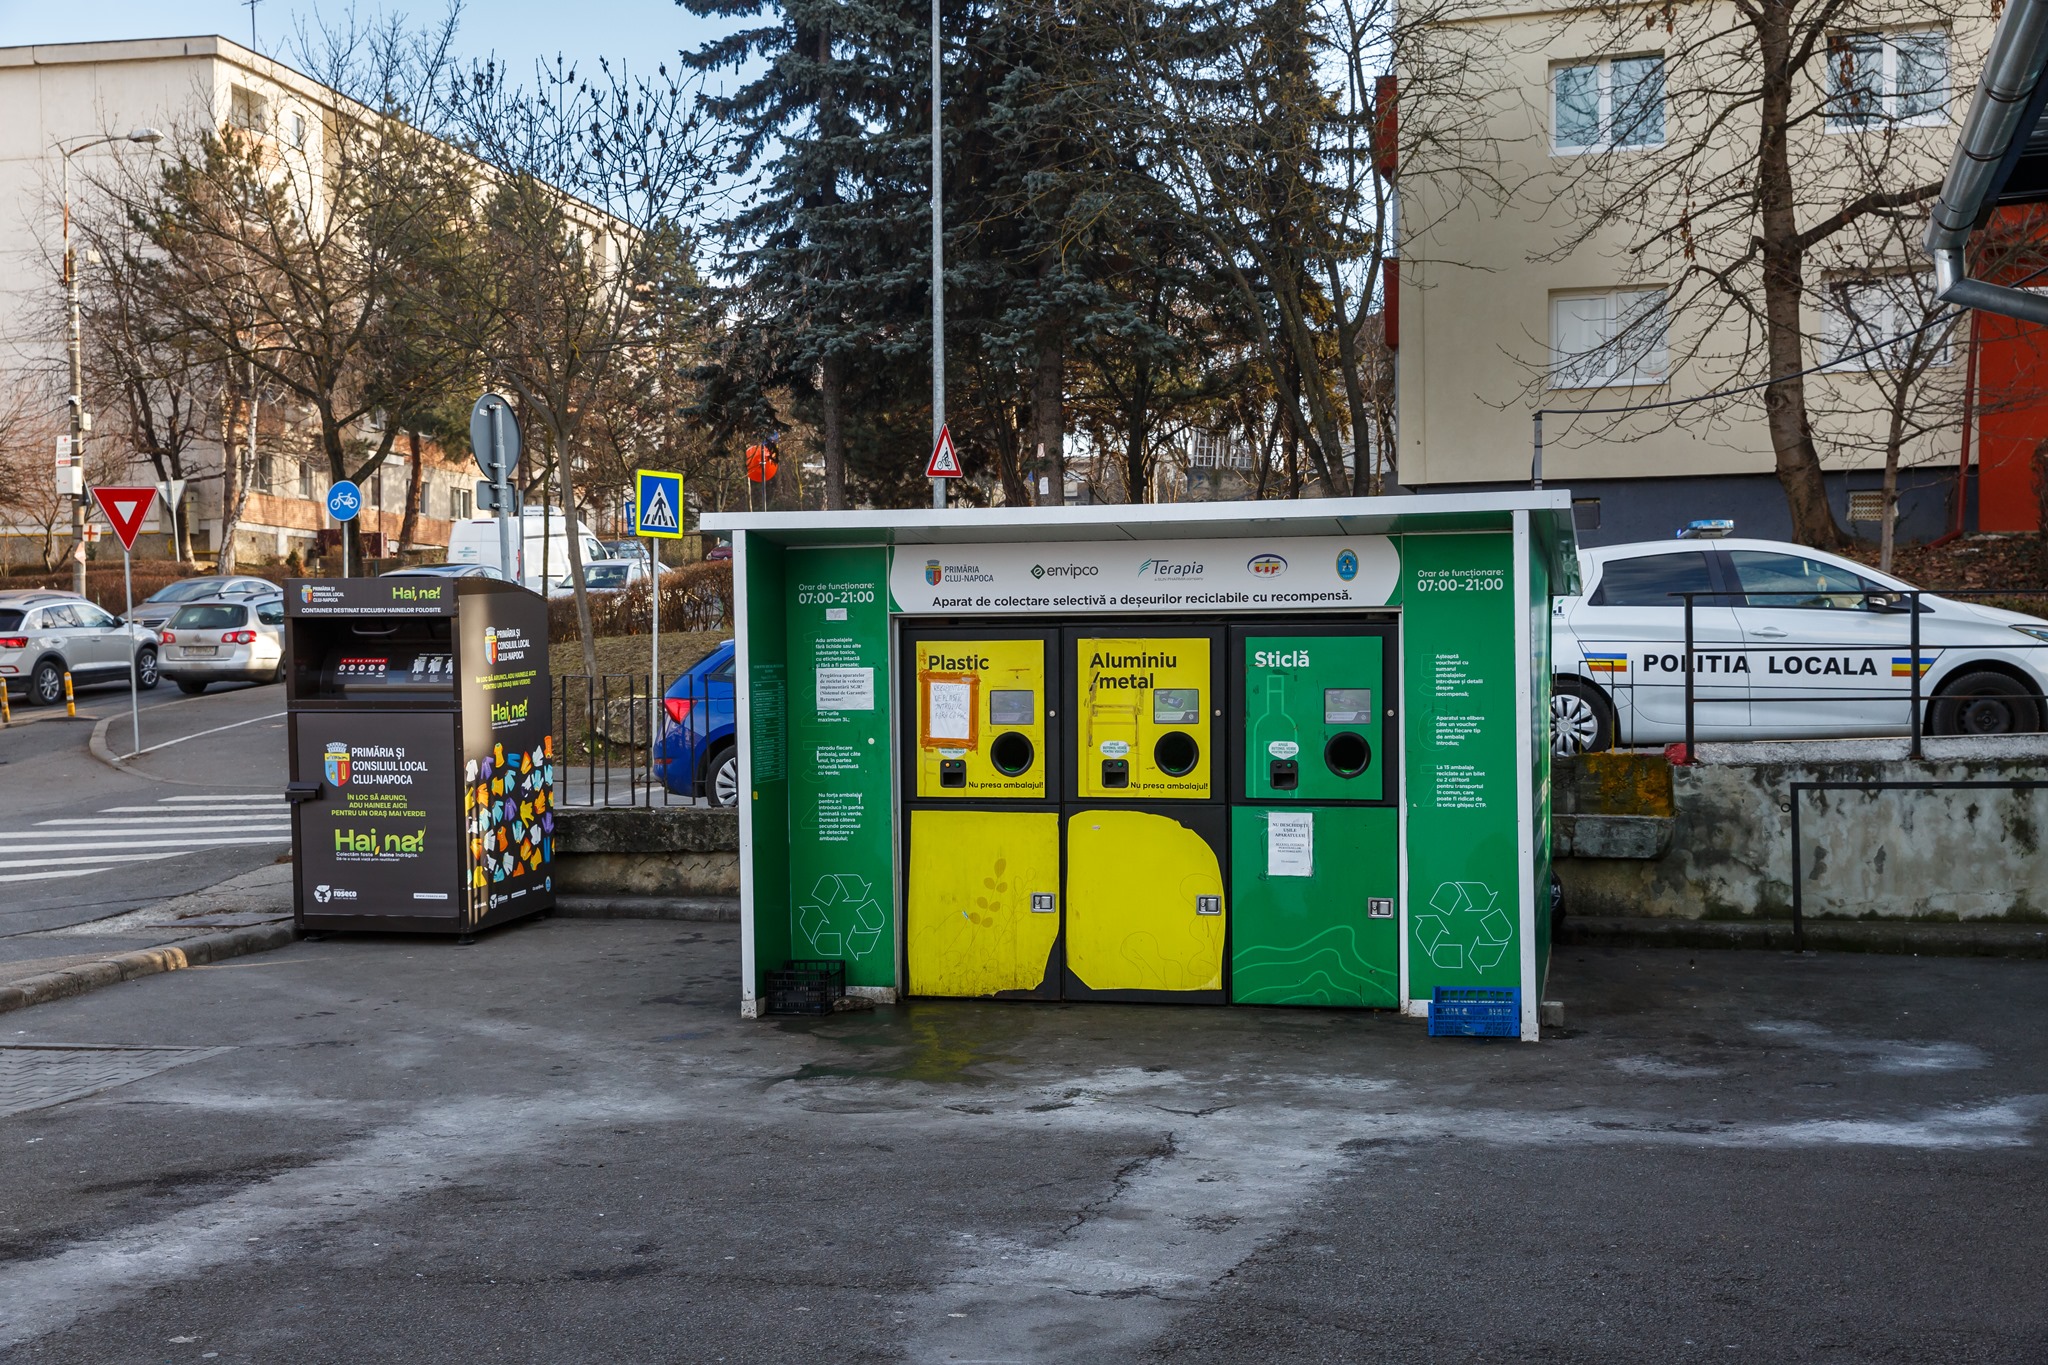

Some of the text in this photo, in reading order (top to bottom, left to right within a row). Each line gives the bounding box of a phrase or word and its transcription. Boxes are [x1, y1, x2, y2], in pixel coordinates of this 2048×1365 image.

[944, 564, 980, 574] PRIMĂRIA
[1047, 563, 1098, 579] envipco
[1151, 560, 1204, 576] Terapia
[1452, 568, 1504, 578] funcționare:
[944, 574, 994, 583] CLUJ-NAPOCA
[817, 582, 826, 590] de
[828, 582, 874, 592] funcționare:
[932, 596, 972, 608] Aparat
[976, 596, 990, 606] de
[994, 596, 1050, 606] colectare
[1053, 594, 1106, 606] selectivă
[1120, 594, 1182, 608] deșeurilor
[1186, 592, 1249, 604] reciclabile
[1253, 594, 1268, 602] cu
[1271, 590, 1352, 603] recompensă.
[518, 639, 530, 648] LOCAL
[928, 654, 990, 670] Plastic
[1090, 652, 1177, 668] Aluminiu
[1254, 650, 1310, 668] Sticlă
[1769, 656, 1878, 676] LOCALA
[1089, 672, 1154, 692] /metal
[351, 745, 405, 760] PRIMĂRIA ȘI
[352, 761, 428, 771] CONSILIUL LOCAL
[352, 774, 413, 784] CLUJ-NAPOCA
[1004, 781, 1044, 790] ambalajul!
[1167, 782, 1208, 791] ambalajul!
